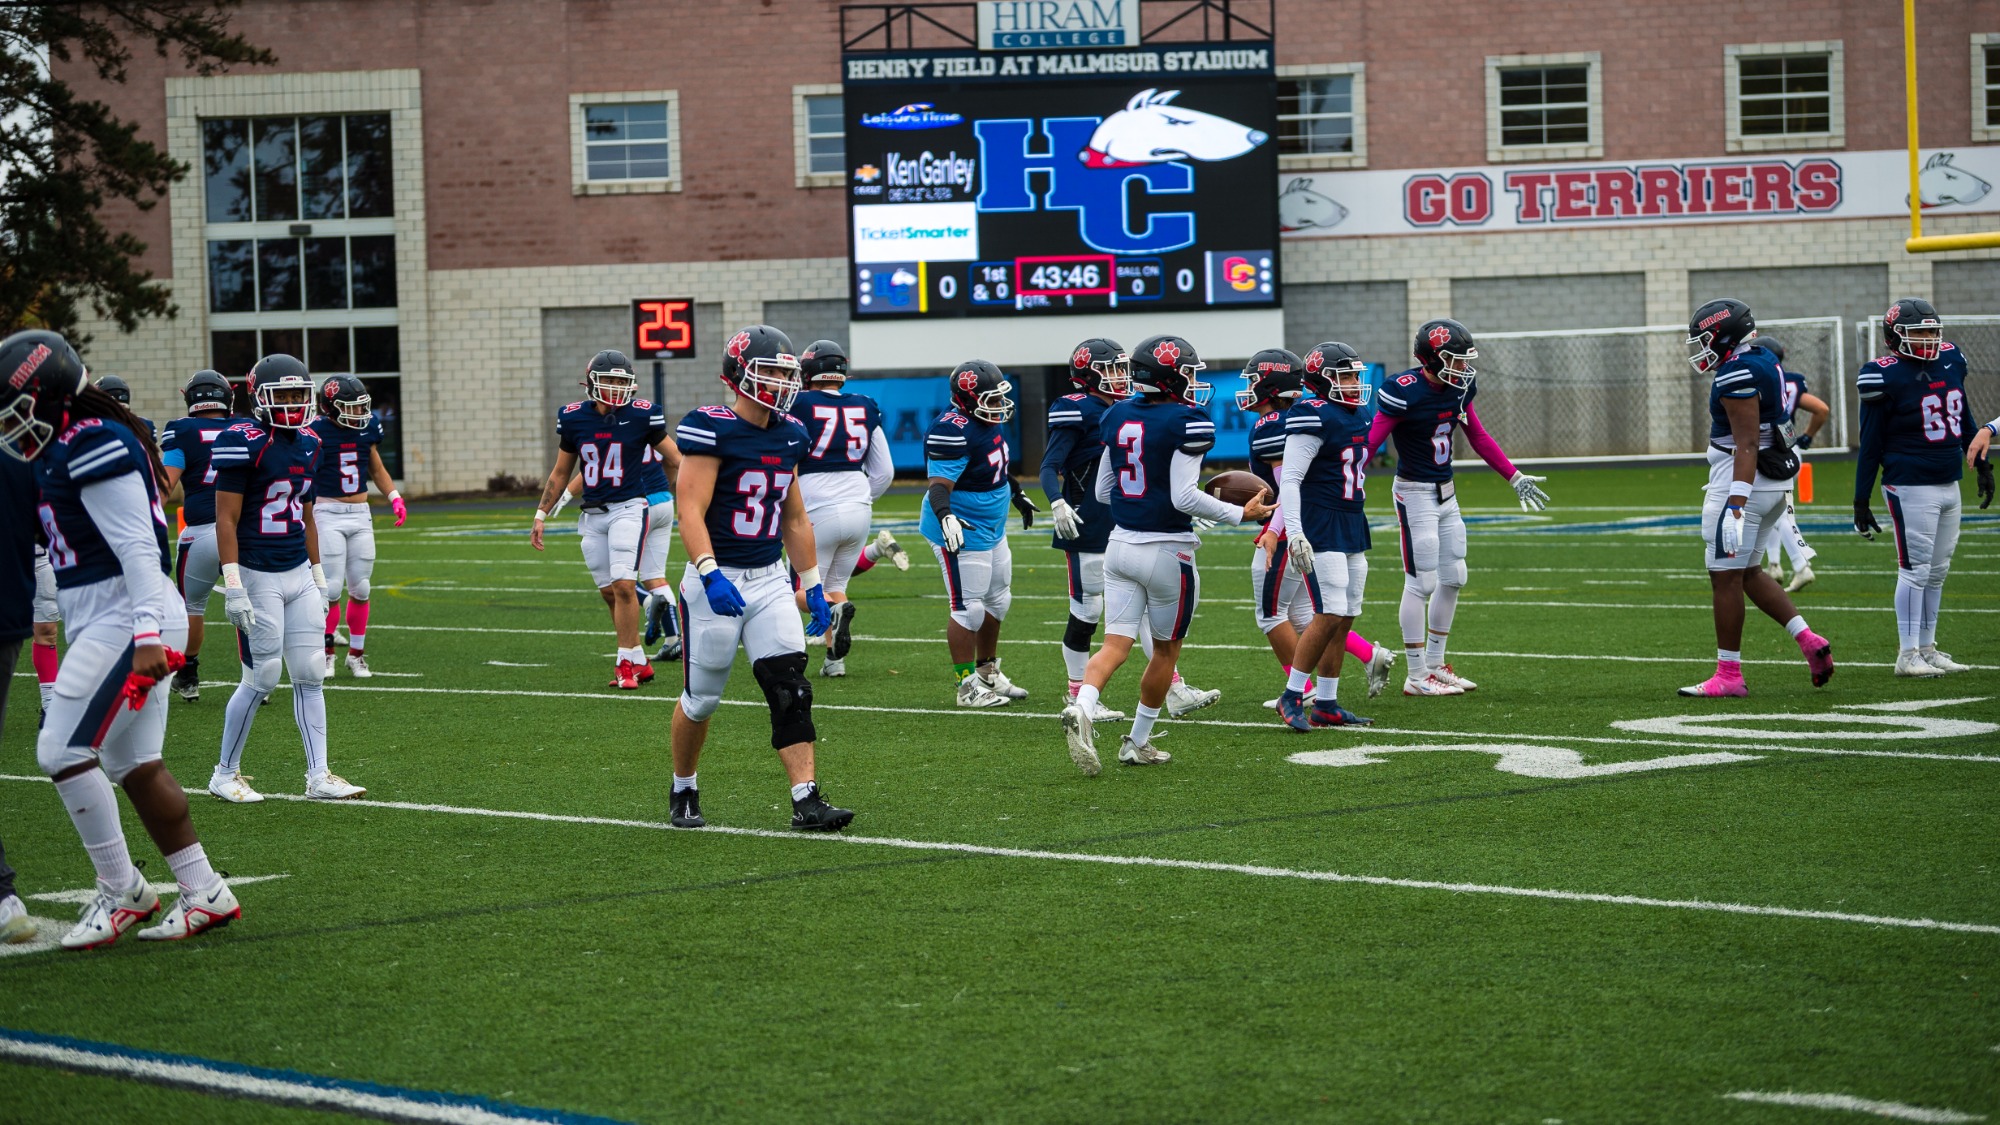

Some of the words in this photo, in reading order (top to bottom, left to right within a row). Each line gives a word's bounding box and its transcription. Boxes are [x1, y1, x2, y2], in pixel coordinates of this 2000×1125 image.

[994, 1, 1124, 31] HIRAM
[1002, 32, 1117, 46] COLLEGE
[848, 58, 928, 79] HENRY
[932, 57, 996, 77] FIELD
[1000, 55, 1033, 76] AT
[1037, 52, 1160, 75] MALMISUR
[1164, 49, 1268, 72] STADIUM
[1403, 172, 1493, 227] GO
[1504, 158, 1842, 224] TERRIERS
[938, 275, 958, 299] 0
[981, 266, 1007, 283] 1st
[1030, 264, 1100, 290] 43:46
[1116, 266, 1141, 278] BALL
[1131, 278, 1146, 296] 0
[1176, 268, 1195, 292] 0
[996, 281, 1009, 299] 0
[638, 302, 691, 349] 25
[1699, 308, 1731, 330] HIRAM
[9, 343, 52, 390] HIRAM
[1258, 361, 1291, 374] HIRAM
[1396, 374, 1417, 387] 6
[1920, 388, 1963, 442] 68
[810, 405, 869, 463] 75
[1431, 422, 1452, 466] 6
[339, 452, 360, 494] 5
[580, 442, 624, 488] 84
[1116, 421, 1148, 498] 3
[1340, 446, 1368, 500] 14
[260, 478, 313, 535] 24
[731, 470, 795, 538] 37
